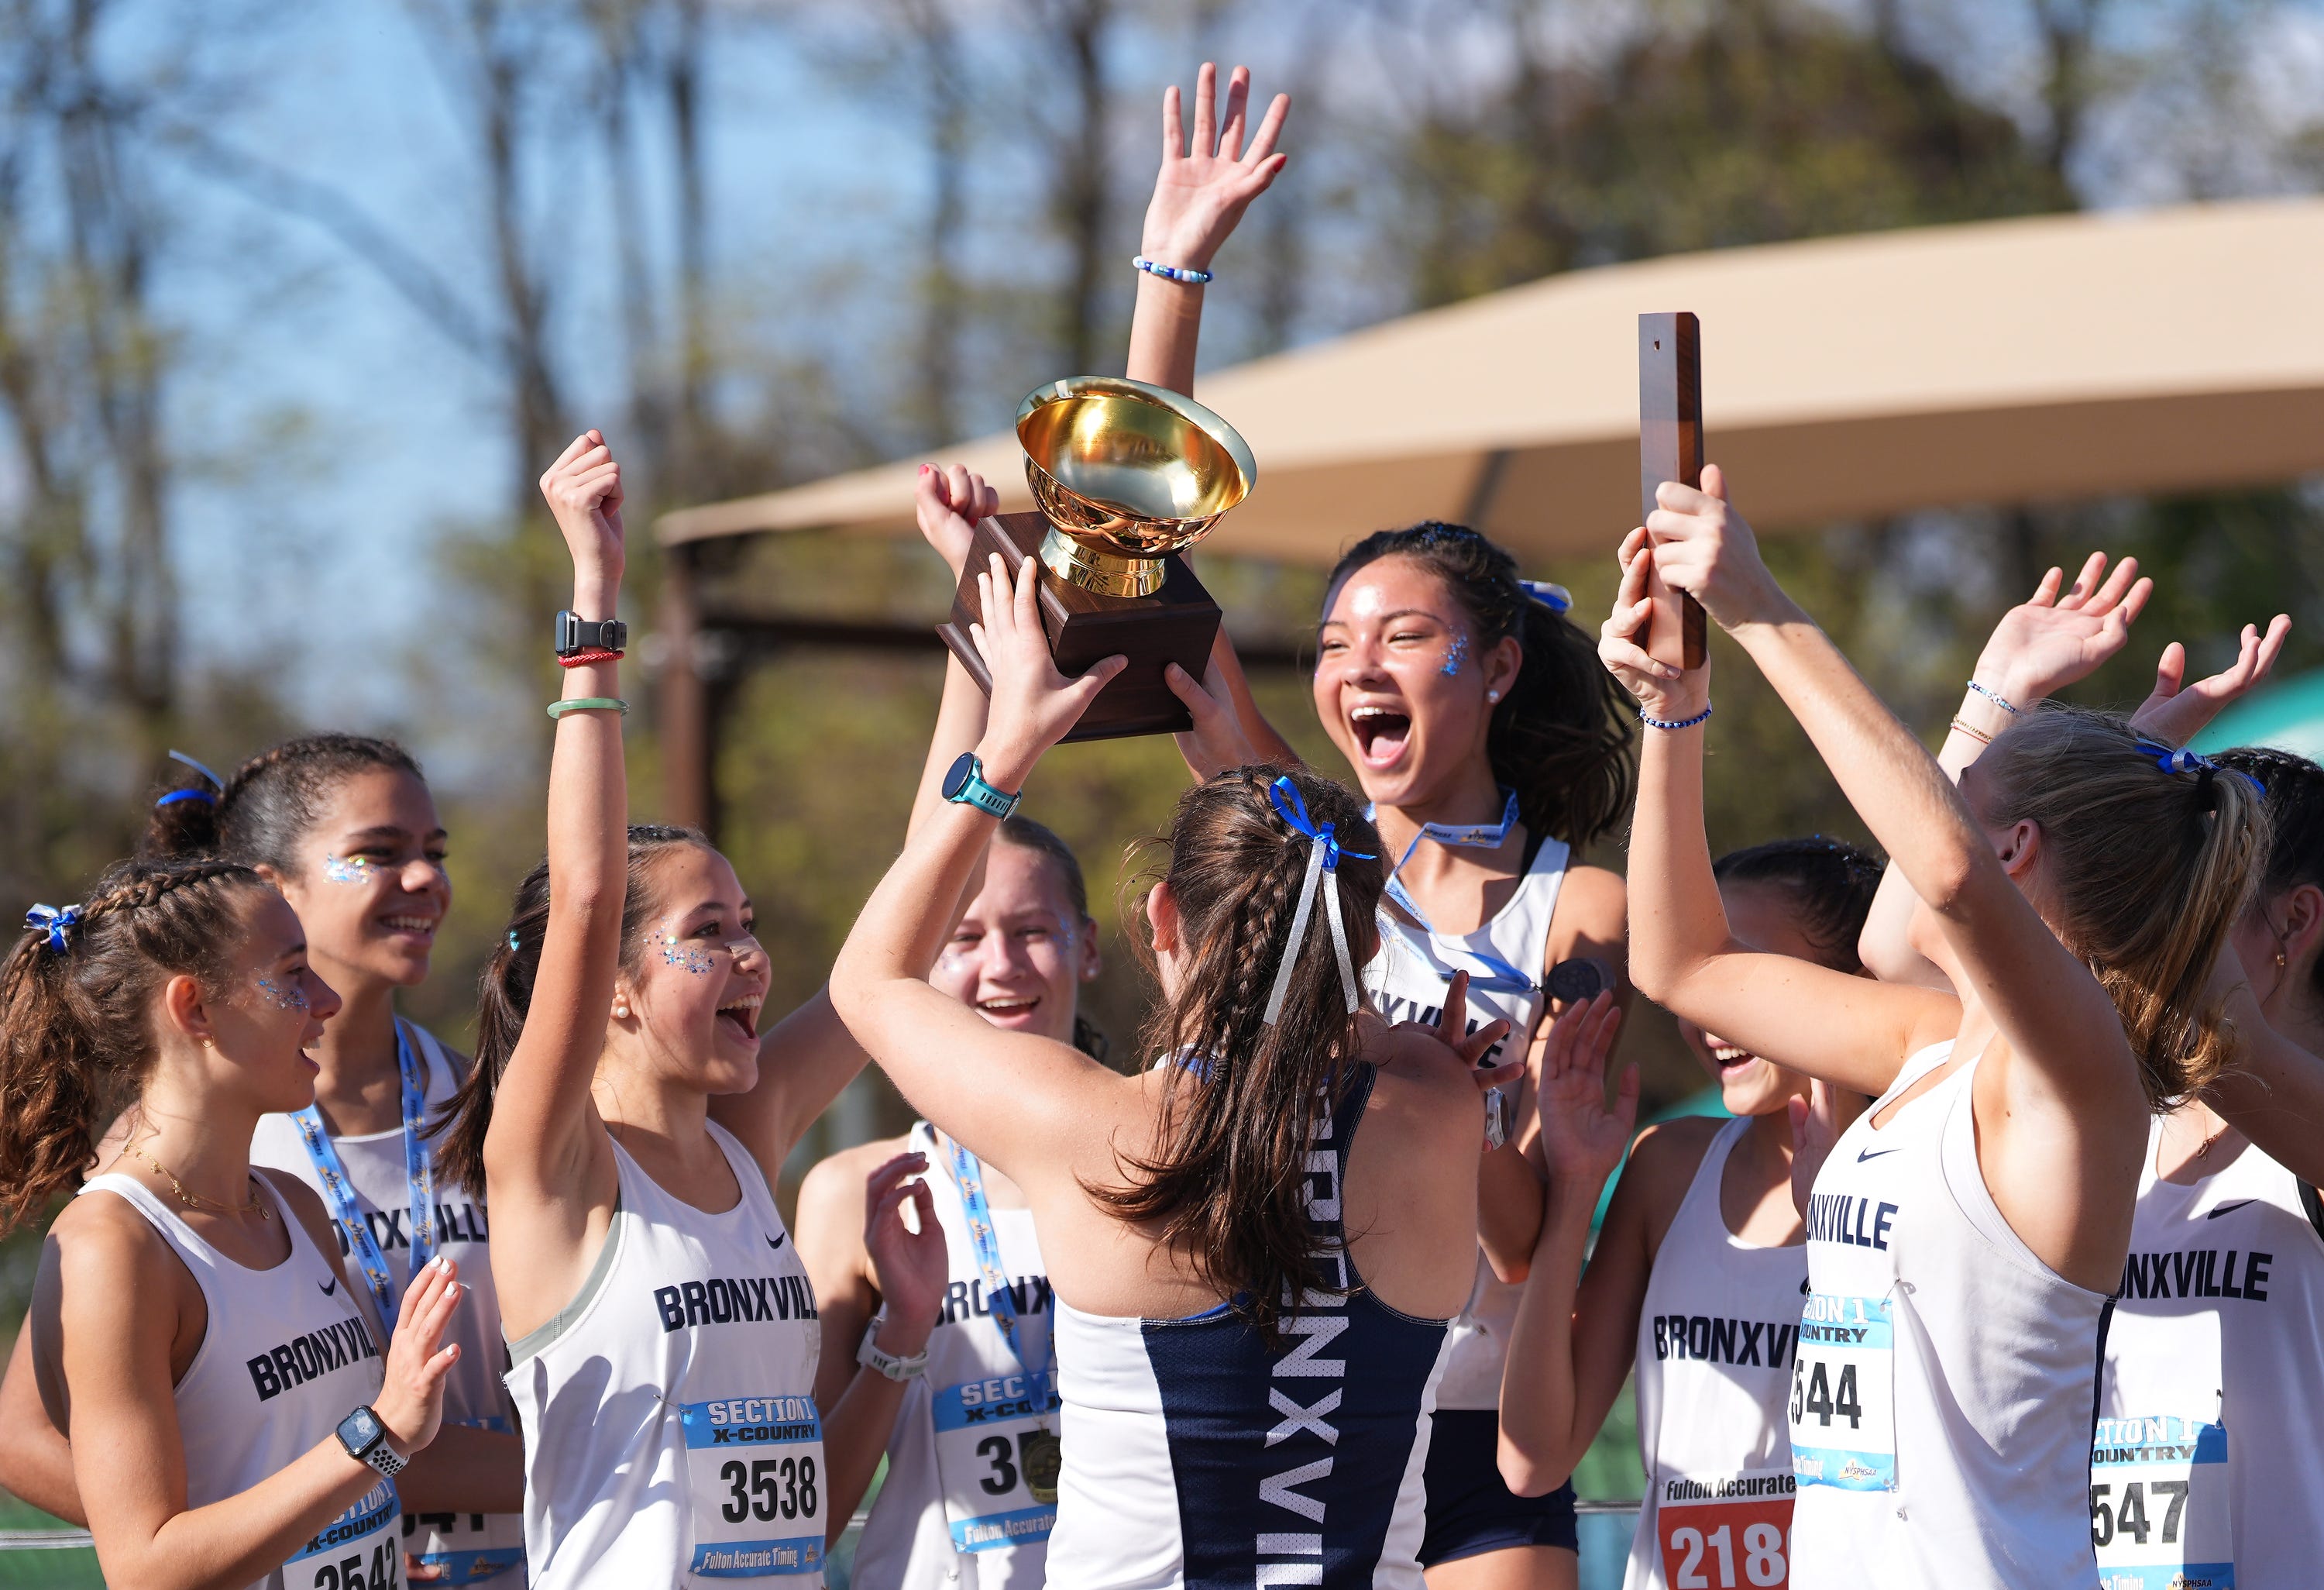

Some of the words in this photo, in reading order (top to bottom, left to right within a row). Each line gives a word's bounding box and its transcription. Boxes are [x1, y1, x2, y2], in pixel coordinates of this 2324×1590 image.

[1806, 1193, 1899, 1252] NXVILLE
[2119, 1250, 2274, 1303] NXVILLE
[1852, 1298, 1870, 1324] 1
[1791, 1358, 1862, 1430] 544
[706, 1398, 806, 1426] SECTION
[803, 1397, 814, 1420] 1
[712, 1423, 816, 1444] X-COUNTRY
[1844, 1466, 1877, 1476] NYSPHSAA
[720, 1456, 817, 1524] 3538
[1666, 1478, 1713, 1501] Fulton
[1716, 1474, 1796, 1499] Accurate
[304, 1500, 395, 1554] X-COUNTRY
[2092, 1480, 2189, 1547] 547
[964, 1523, 1004, 1545] Fulton
[701, 1551, 733, 1571] Fulton
[733, 1549, 772, 1569] Accurate
[772, 1546, 799, 1568] Timing
[1670, 1523, 1792, 1590] 218
[2172, 1579, 2212, 1588] NYSPHSAA
